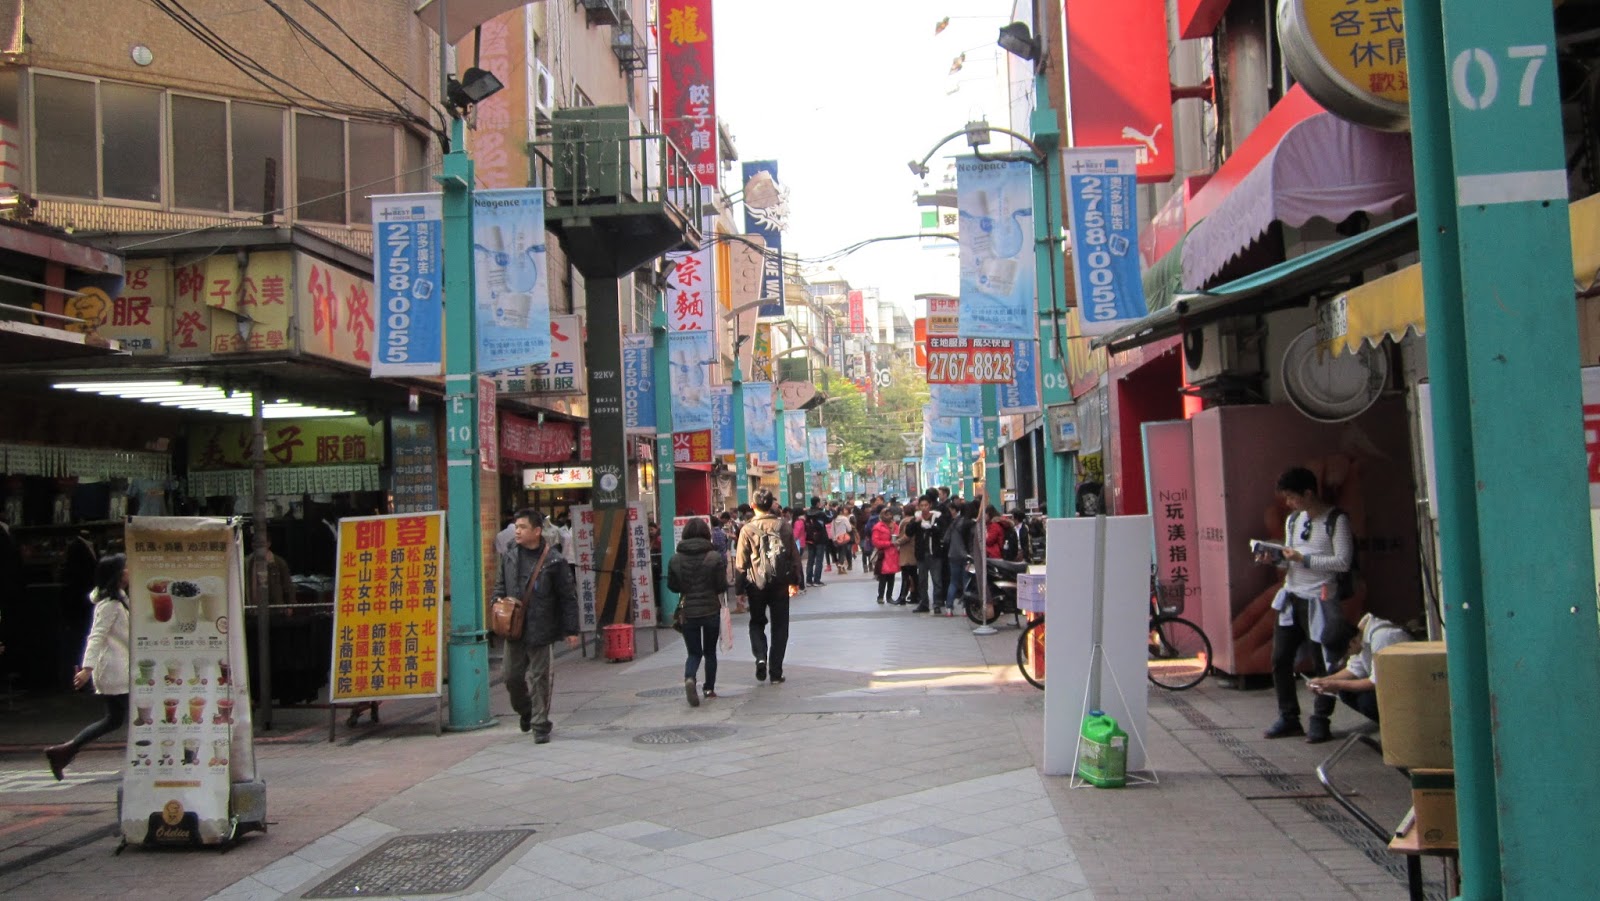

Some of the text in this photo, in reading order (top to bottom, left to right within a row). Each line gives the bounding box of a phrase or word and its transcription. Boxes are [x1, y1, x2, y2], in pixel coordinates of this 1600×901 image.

[664, 5, 708, 45] 龍
[1330, 7, 1404, 37] 各式
[1452, 44, 1547, 111] 07
[689, 84, 711, 150] 餃子館
[958, 162, 1007, 172] Neogence
[474, 199, 520, 208] Neogence
[674, 256, 703, 330] 宗麵
[593, 371, 614, 379] 22KV
[929, 352, 1012, 381] 2767-8823
[1044, 372, 1068, 389] 09
[453, 396, 464, 414] E
[316, 434, 366, 464] 服飾
[449, 426, 470, 441] 10
[660, 445, 668, 456] E
[674, 433, 690, 462] 火鍋
[987, 428, 994, 439] E
[659, 463, 671, 472] 12
[1160, 488, 1188, 501] Nail
[355, 516, 427, 550] 帥登
[578, 529, 590, 575] 北一女中
[634, 525, 647, 570] 成功高中
[341, 552, 357, 617] 北一女中
[357, 550, 372, 616] 中山女中
[373, 549, 389, 615] 景美女中
[389, 548, 405, 615] 師大附中
[406, 547, 421, 613] 松山高中
[422, 545, 437, 612] 成功高中
[337, 625, 353, 694] 北商學院
[354, 624, 370, 692] 建國中學
[371, 623, 386, 691] 師範大學
[387, 621, 402, 690] 板橋高中
[404, 621, 419, 689] 大同高中
[420, 619, 435, 688] 北士商
